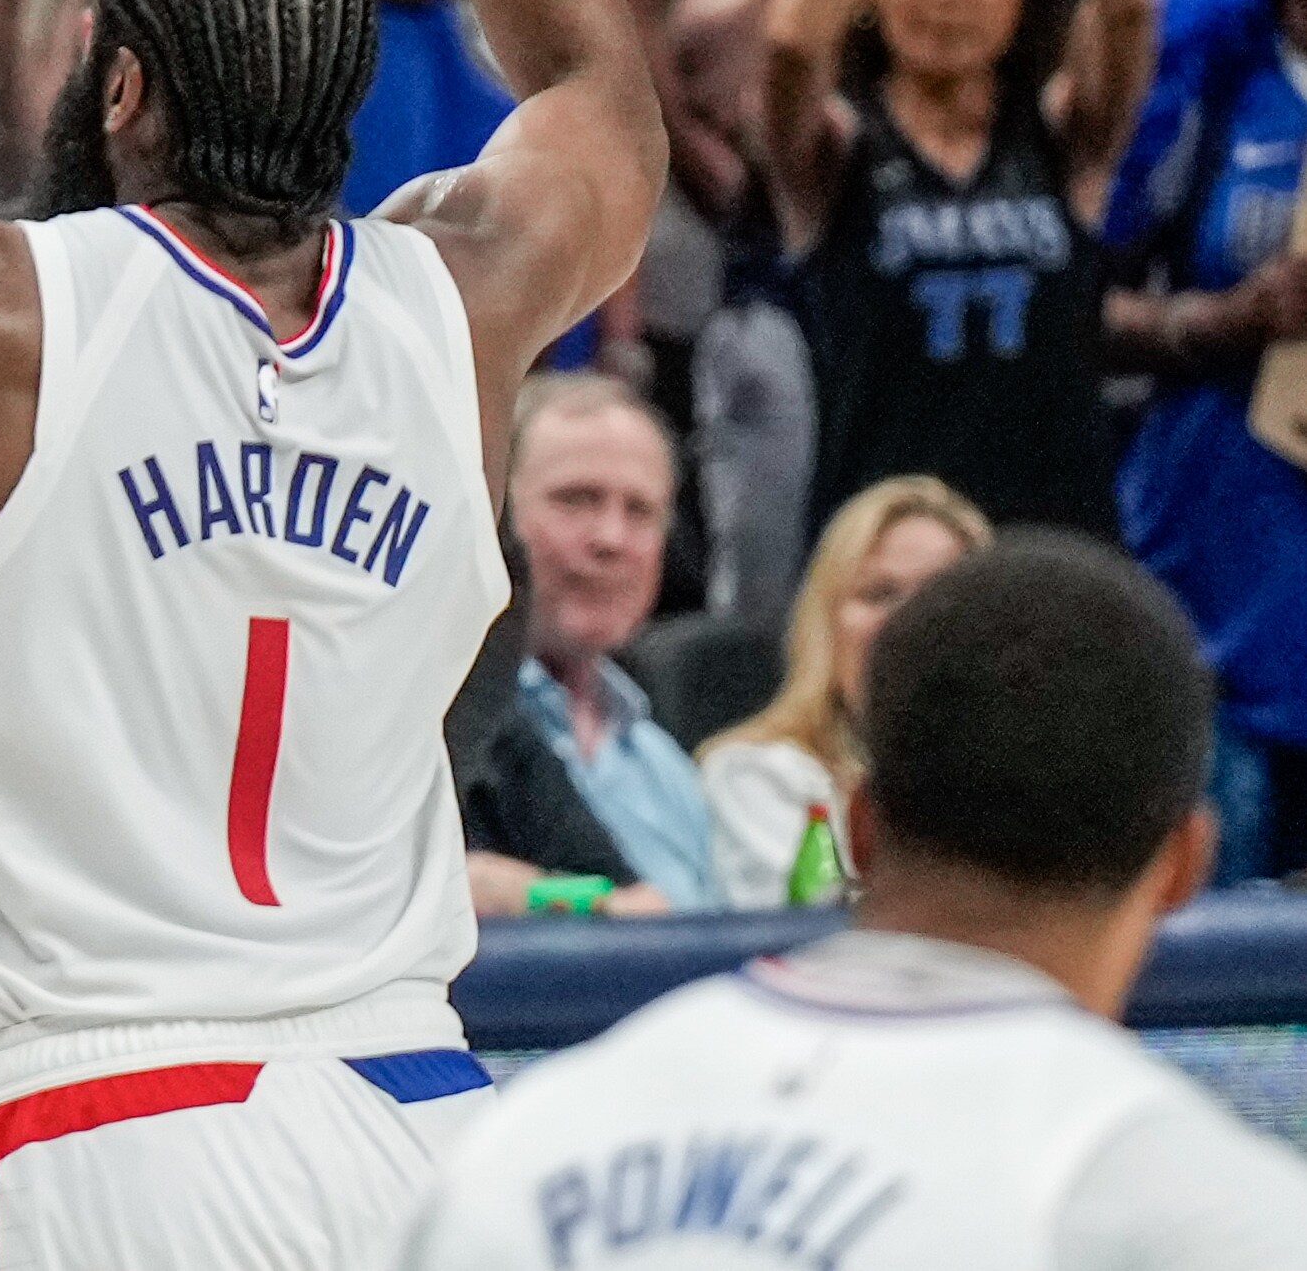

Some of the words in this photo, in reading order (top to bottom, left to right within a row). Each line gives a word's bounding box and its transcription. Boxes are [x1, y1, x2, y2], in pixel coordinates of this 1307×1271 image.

[117, 438, 432, 588] HARDEN
[227, 615, 290, 907] 1
[538, 1130, 911, 1271] POWELL
